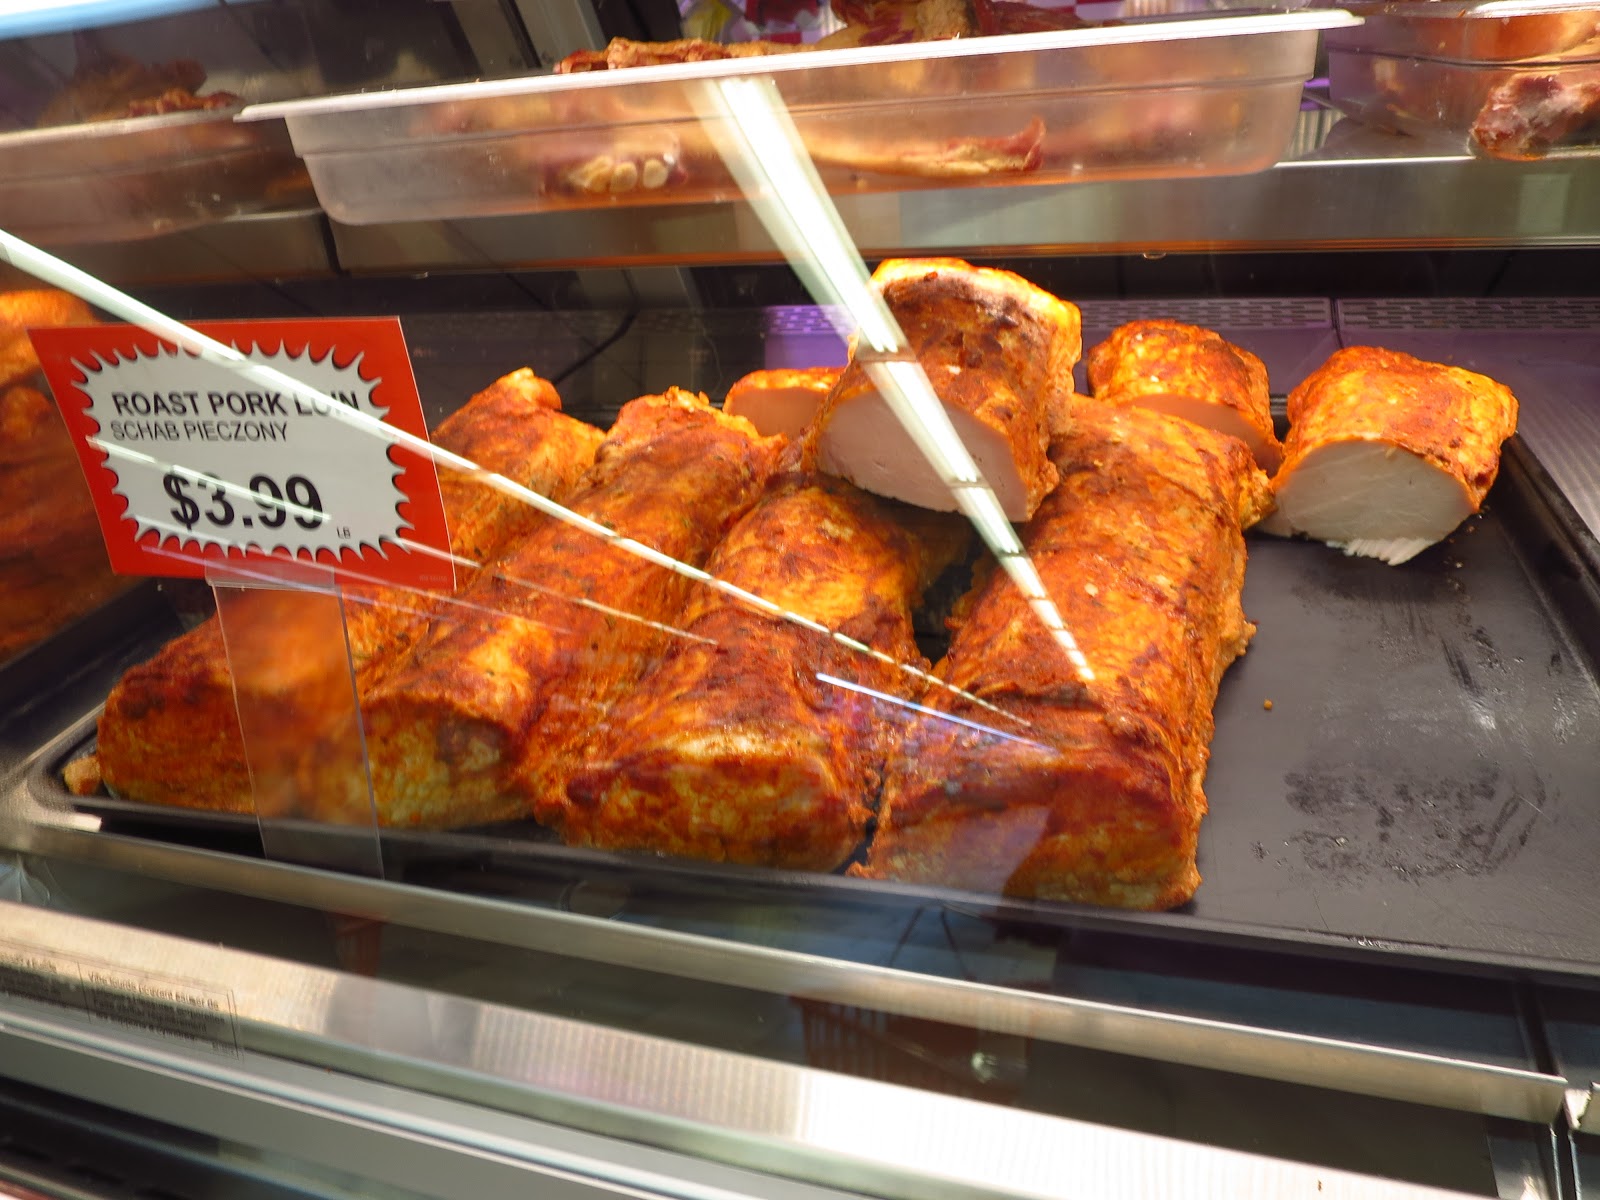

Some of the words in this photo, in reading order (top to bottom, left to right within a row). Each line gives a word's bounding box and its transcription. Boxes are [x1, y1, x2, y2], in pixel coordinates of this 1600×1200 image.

[112, 391, 200, 416] ROAST
[207, 391, 288, 416] PORK
[110, 420, 180, 441] SCHAB
[183, 420, 288, 442] PIECZONY
[163, 472, 323, 531] $3.99
[337, 527, 351, 539] LB
